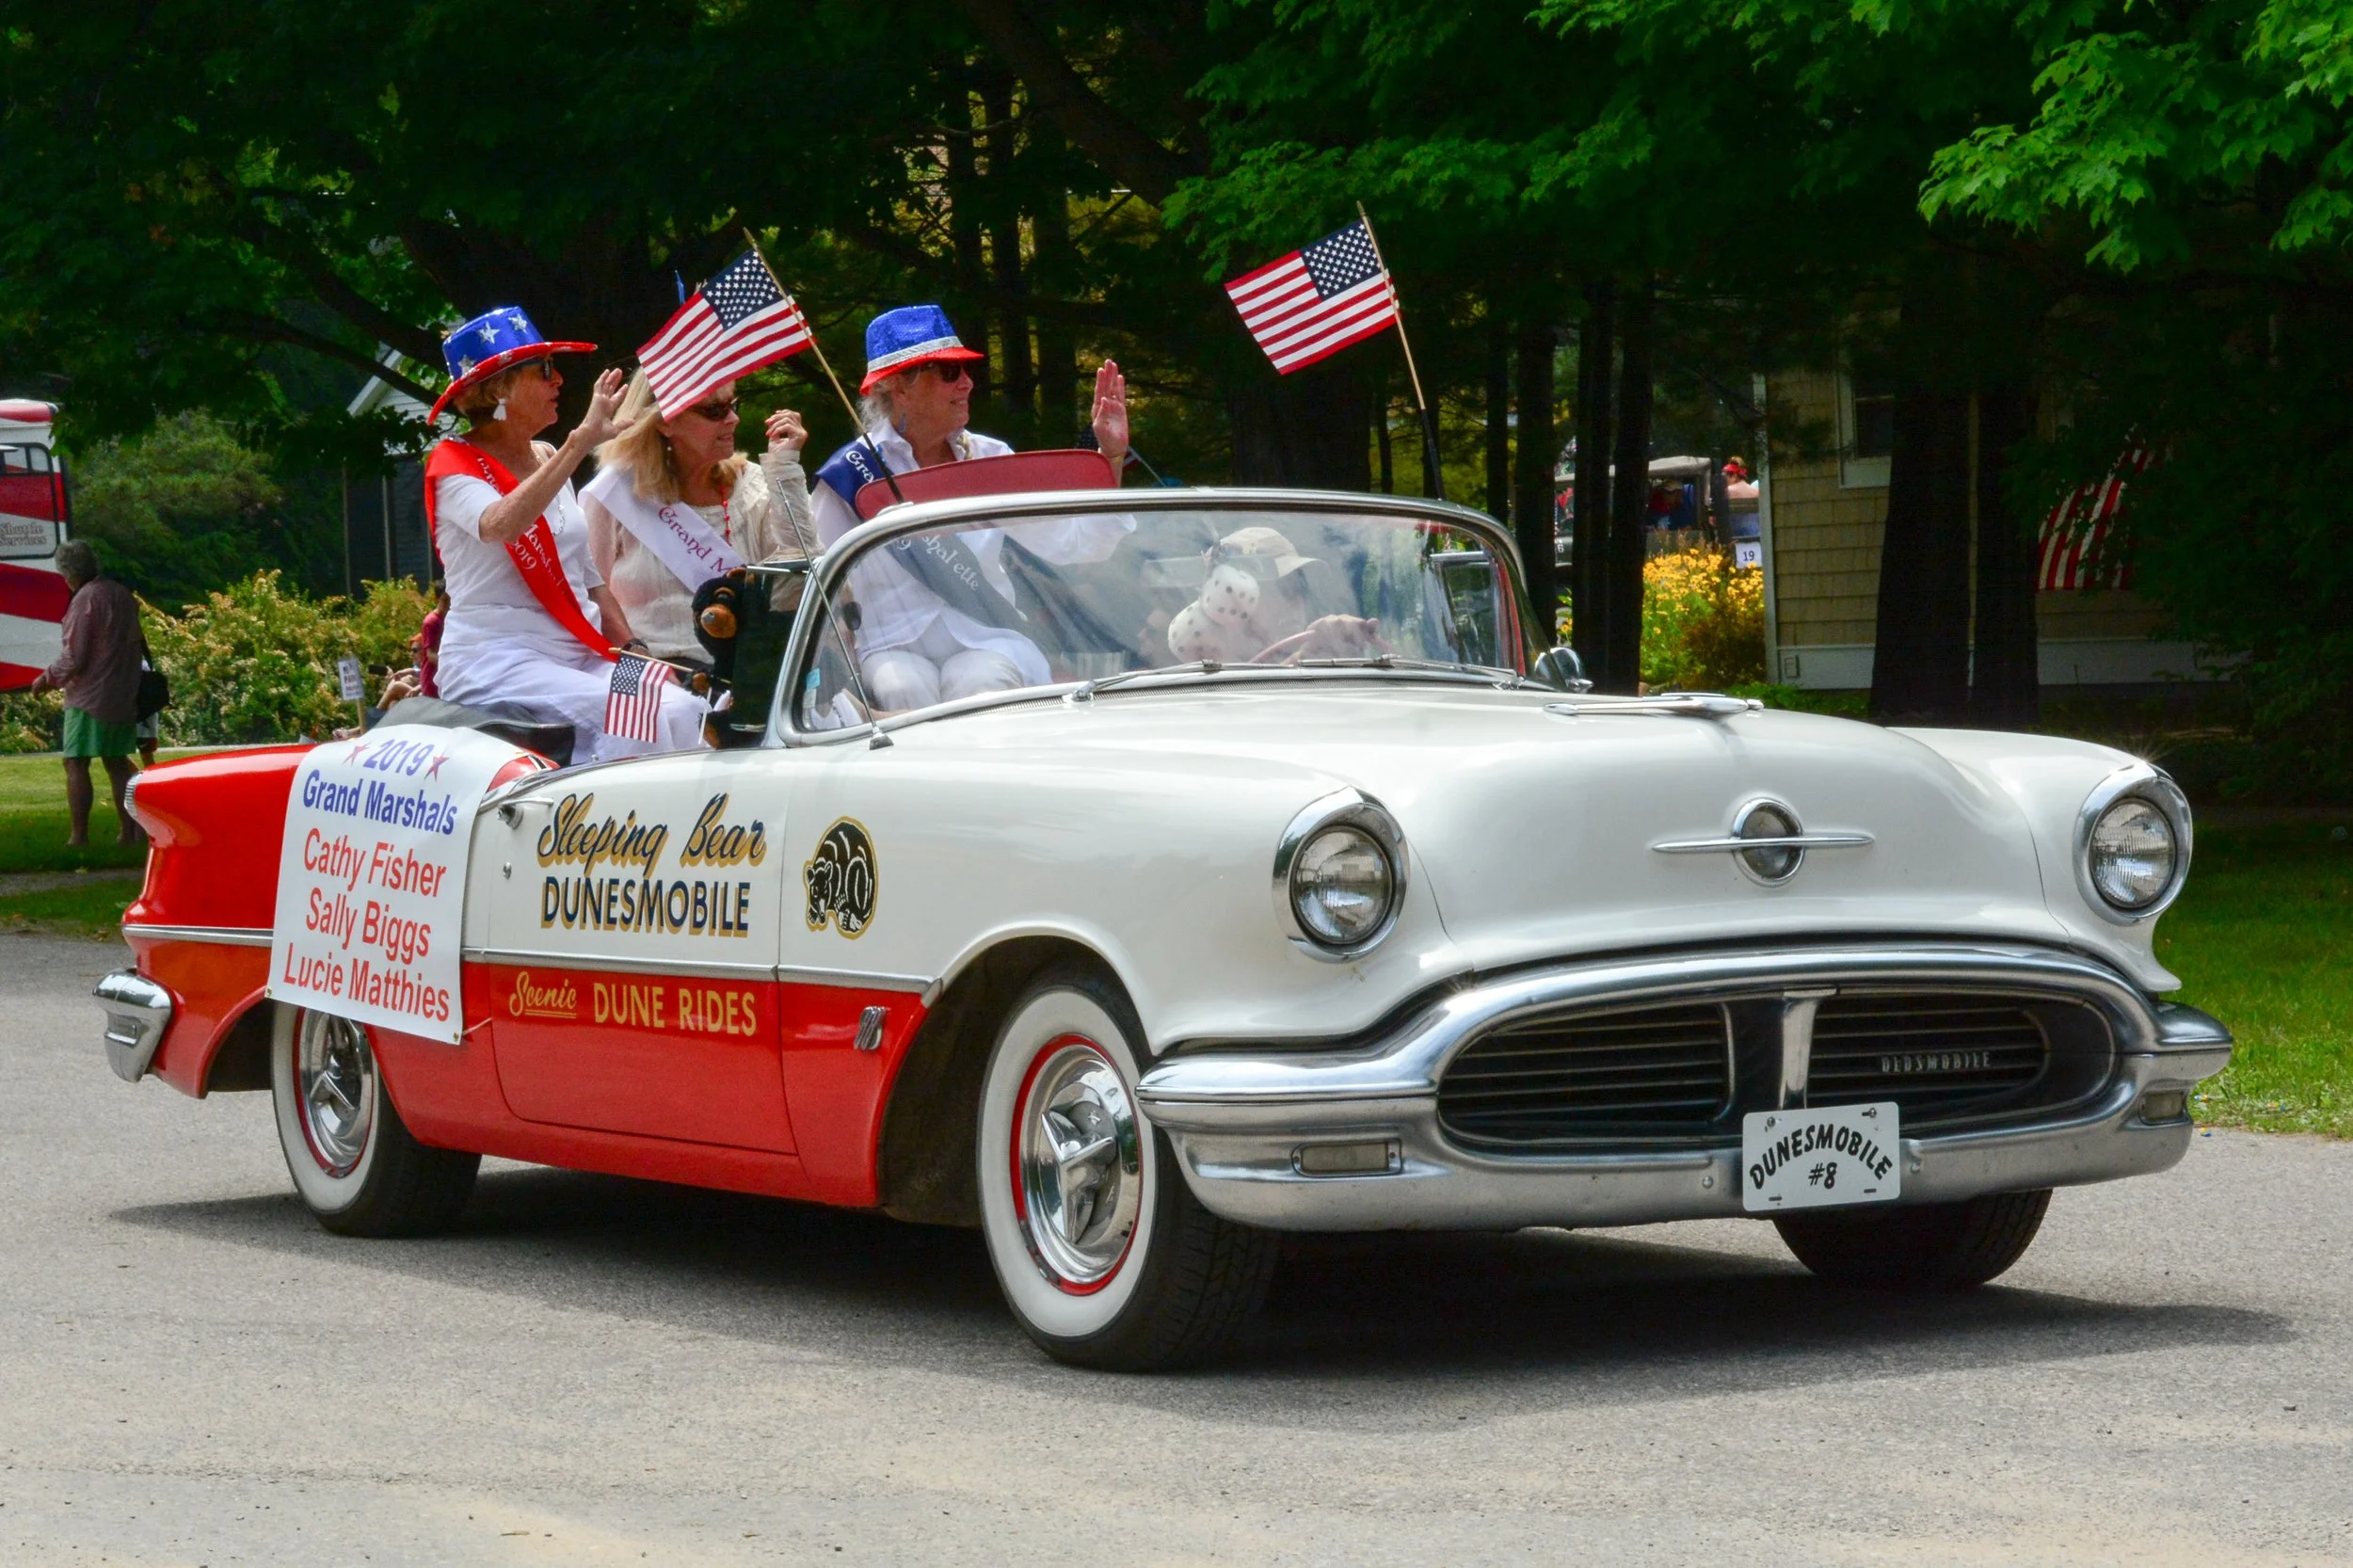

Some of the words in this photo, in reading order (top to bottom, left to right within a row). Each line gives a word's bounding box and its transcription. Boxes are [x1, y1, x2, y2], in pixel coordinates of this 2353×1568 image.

[845, 450, 874, 484] Gra
[659, 506, 712, 560] Grand
[1742, 550, 1755, 562] 19
[362, 738, 436, 776] 2019
[302, 769, 362, 817] Grand
[363, 781, 458, 836] Marshals
[303, 827, 367, 892] Cathy
[368, 841, 447, 898] Fisher
[536, 792, 670, 880] Sleeping
[680, 792, 767, 869] Bear
[305, 888, 358, 951] Sally
[361, 900, 432, 966] Biggs
[540, 875, 751, 938] DUNESMOBILE
[283, 942, 344, 998] Lucie
[347, 957, 451, 1022] Matthies
[509, 971, 577, 1017] Scenic
[593, 983, 665, 1030] DUNE
[678, 988, 758, 1036] RIDES
[1881, 1051, 1992, 1073] OLDSMOBILE
[1749, 1124, 1894, 1190] DUNESMOBILE
[1808, 1161, 1838, 1190] #8
